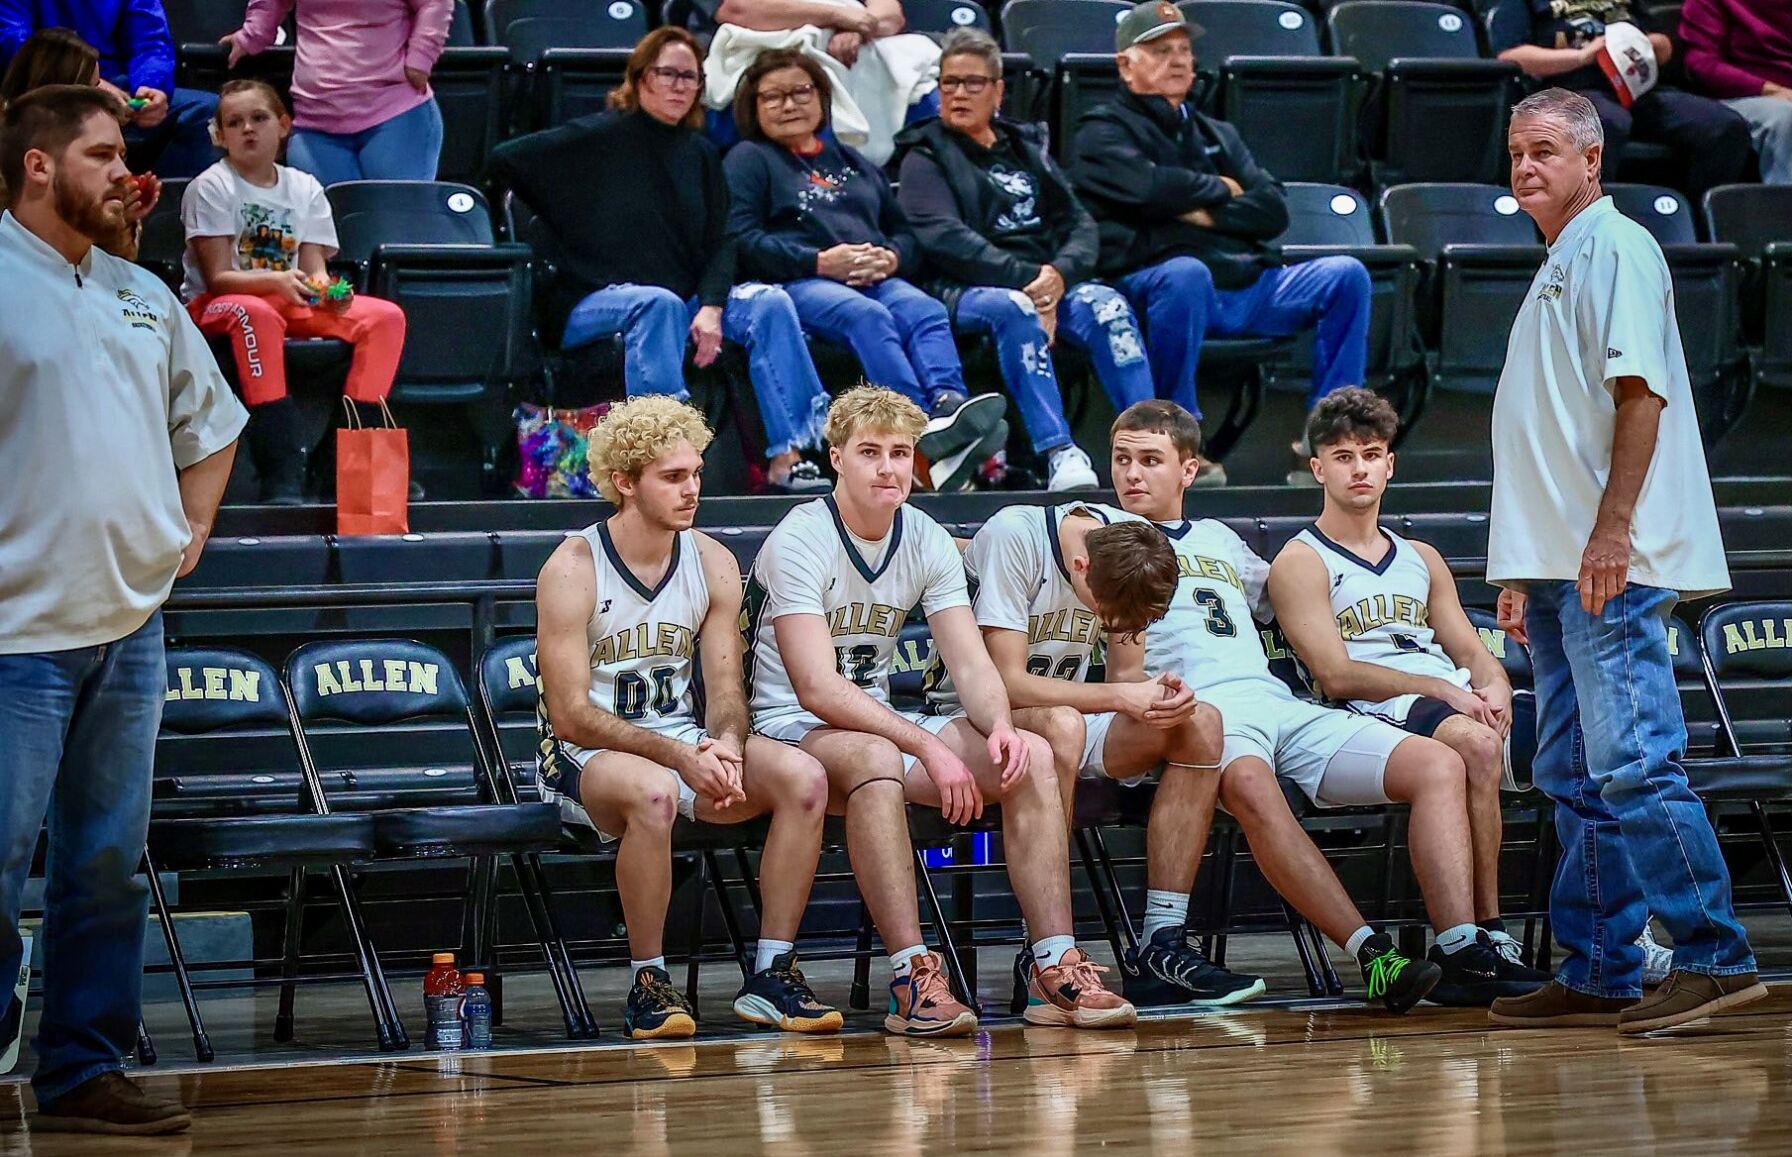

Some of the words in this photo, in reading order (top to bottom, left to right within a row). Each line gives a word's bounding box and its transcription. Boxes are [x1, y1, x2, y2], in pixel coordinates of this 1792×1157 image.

[1176, 554, 1247, 601] LEN
[825, 602, 908, 637] LLE
[1192, 587, 1237, 638] 3
[590, 622, 695, 669] ALLEN
[1723, 619, 1792, 654] ALL
[164, 667, 260, 702] LEN
[314, 659, 439, 697] ALLEN
